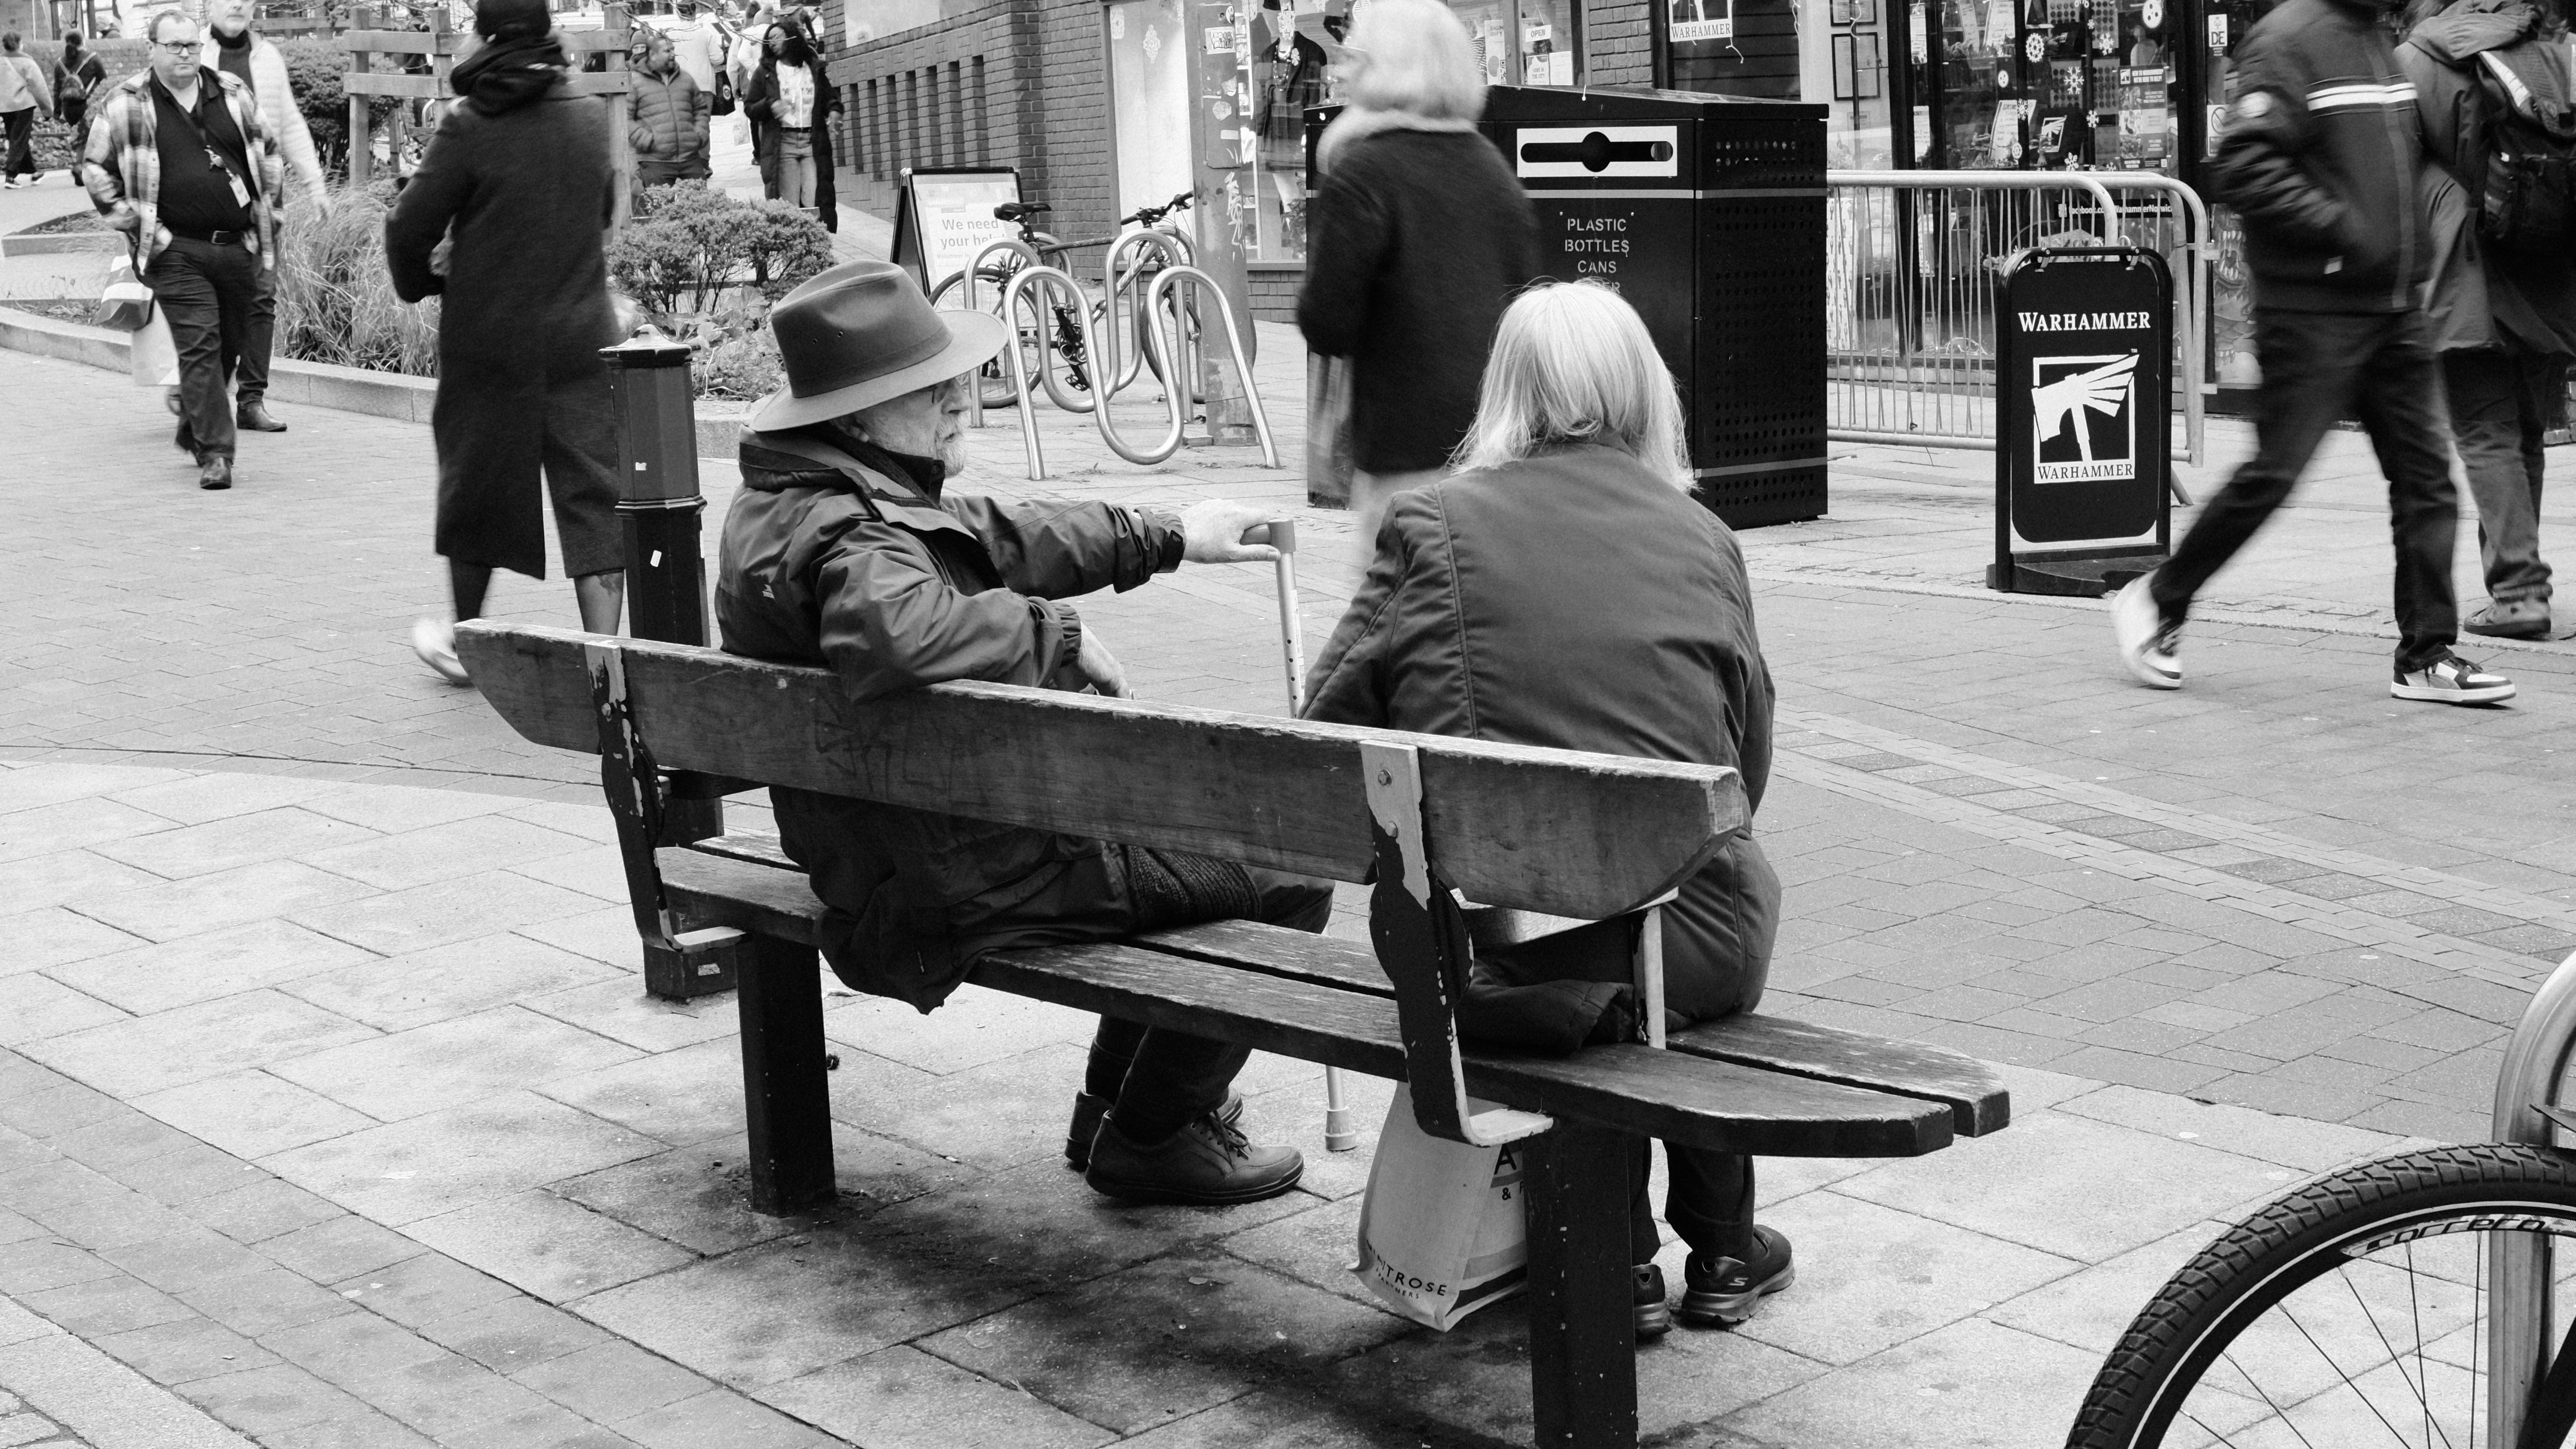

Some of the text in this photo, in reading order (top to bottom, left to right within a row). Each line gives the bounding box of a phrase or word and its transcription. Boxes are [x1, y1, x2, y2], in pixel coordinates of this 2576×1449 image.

[1531, 28, 1546, 38] OPEN
[1671, 23, 1731, 39] WARHAMMER
[2211, 30, 2225, 45] DE
[942, 218, 998, 230] We need
[1567, 218, 1626, 231] PLASTIC
[941, 238, 969, 250] your
[1565, 239, 1629, 252] BOTTLES
[1578, 260, 1616, 273] CANS
[2018, 312, 2151, 332] WARHAMMER
[2037, 464, 2133, 480] WARHAMMER
